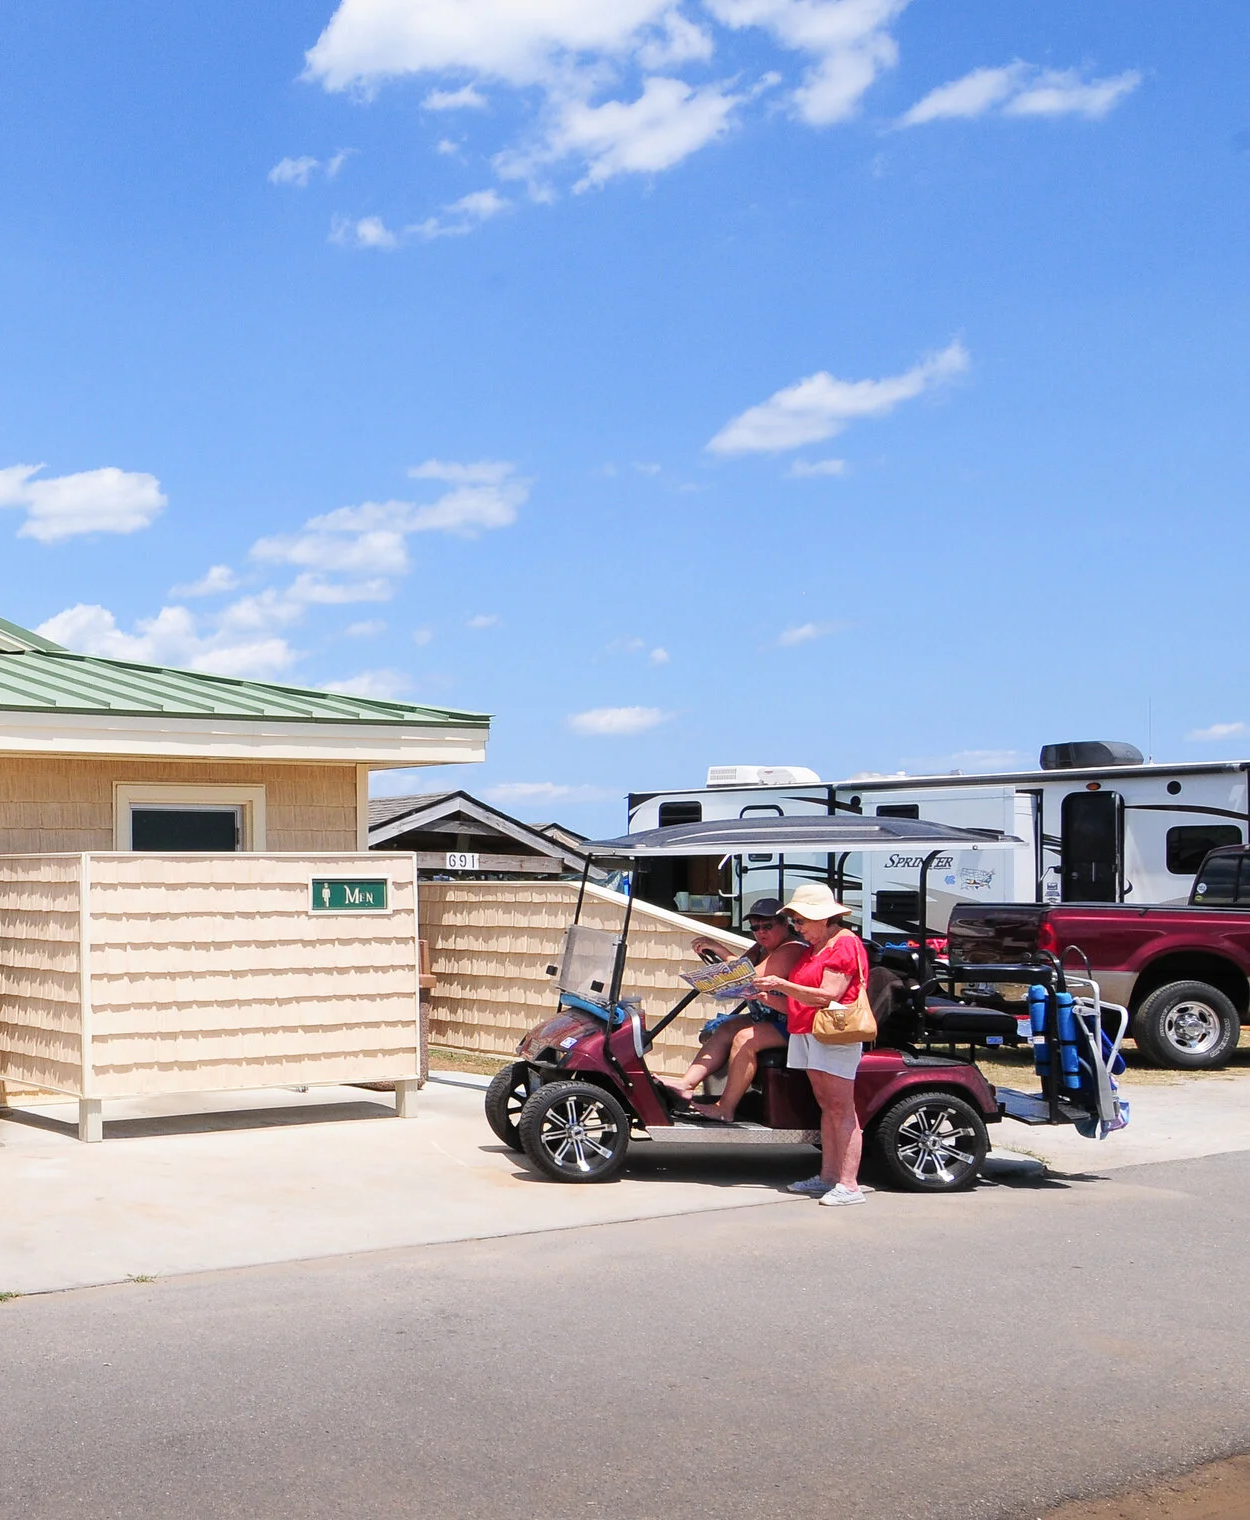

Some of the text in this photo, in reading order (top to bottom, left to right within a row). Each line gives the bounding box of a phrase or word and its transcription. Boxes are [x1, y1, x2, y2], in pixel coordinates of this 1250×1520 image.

[449, 854, 475, 868] 691
[884, 853, 953, 870] SPRINER
[344, 885, 374, 904] MEN
